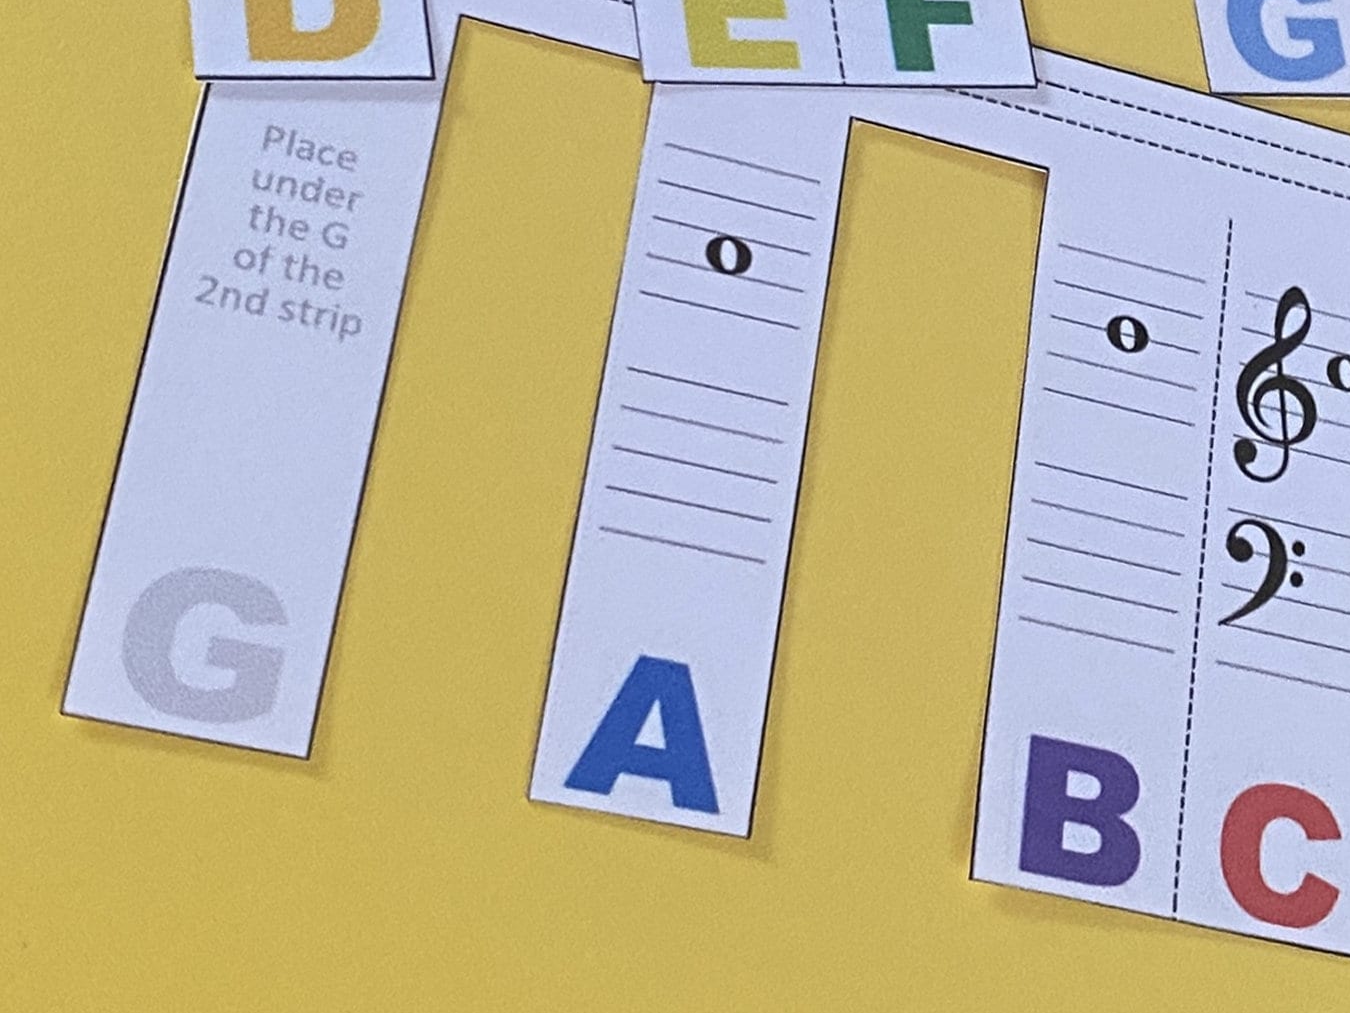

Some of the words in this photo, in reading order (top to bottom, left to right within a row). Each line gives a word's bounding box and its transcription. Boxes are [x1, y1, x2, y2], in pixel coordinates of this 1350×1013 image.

[262, 124, 359, 173] Place
[251, 168, 365, 212] under
[249, 204, 310, 241] the
[321, 222, 350, 250] G
[233, 244, 274, 274] of
[283, 254, 346, 291] the
[194, 275, 270, 316] 2nd
[276, 298, 363, 342] strip
[122, 568, 288, 722] G
[566, 654, 720, 815] A
[1019, 734, 1142, 888] B
[1220, 783, 1343, 930] C
